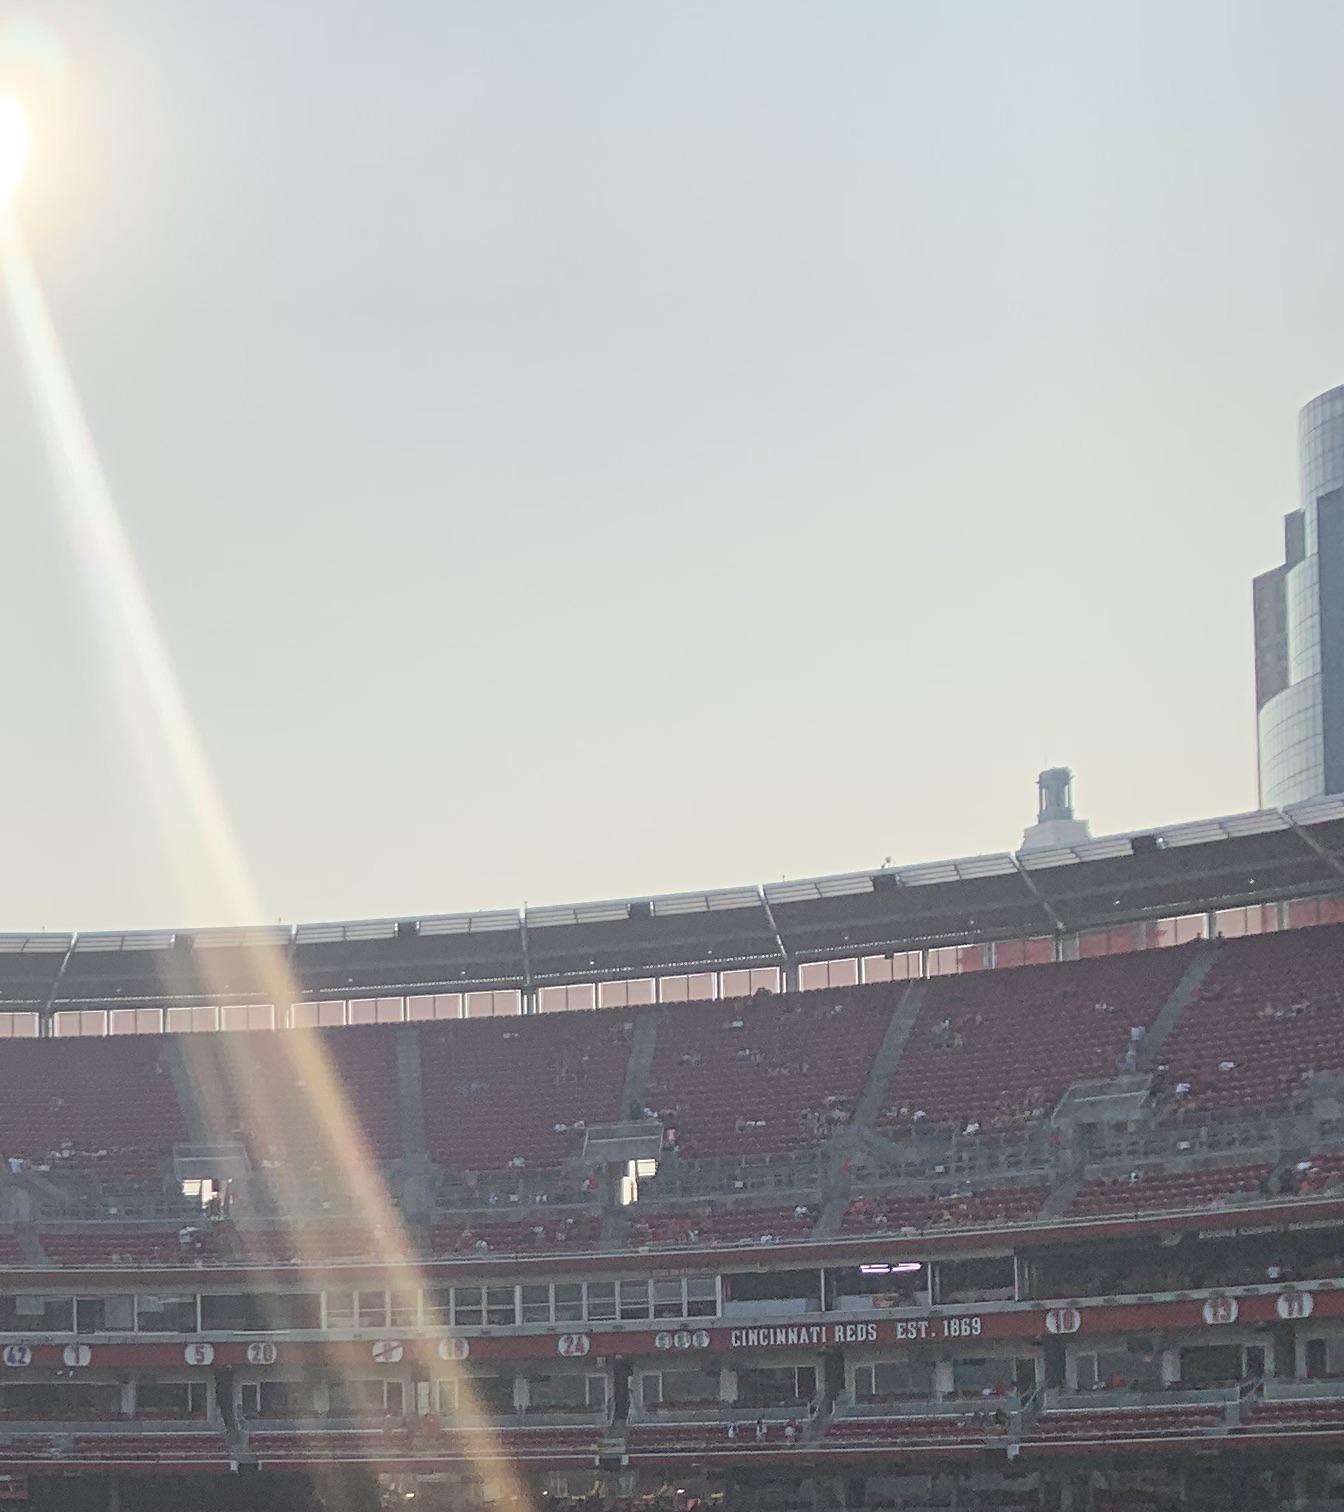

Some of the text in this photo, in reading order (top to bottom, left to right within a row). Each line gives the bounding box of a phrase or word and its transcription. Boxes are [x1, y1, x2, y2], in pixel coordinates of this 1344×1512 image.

[562, 1334, 586, 1354] 24
[730, 1317, 982, 1348] CINCINNATI REDS EST. 1869
